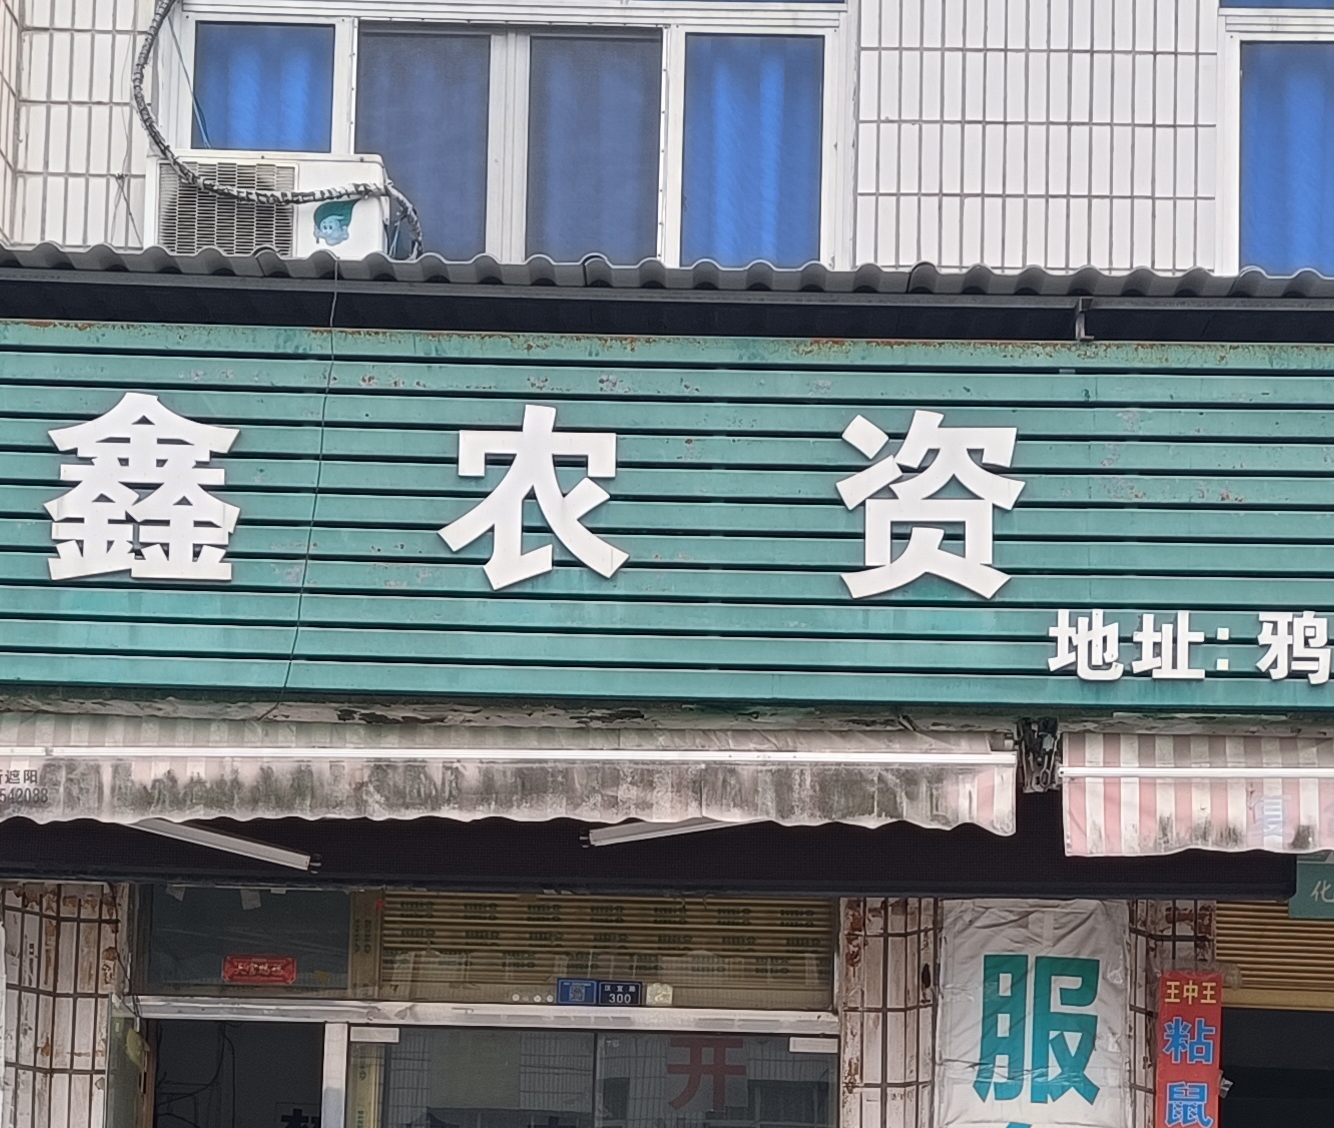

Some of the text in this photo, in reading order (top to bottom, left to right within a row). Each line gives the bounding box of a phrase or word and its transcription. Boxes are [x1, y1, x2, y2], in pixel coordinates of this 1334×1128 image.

[608, 993, 632, 1004] 300
[1165, 980, 1217, 1005] 王中王
